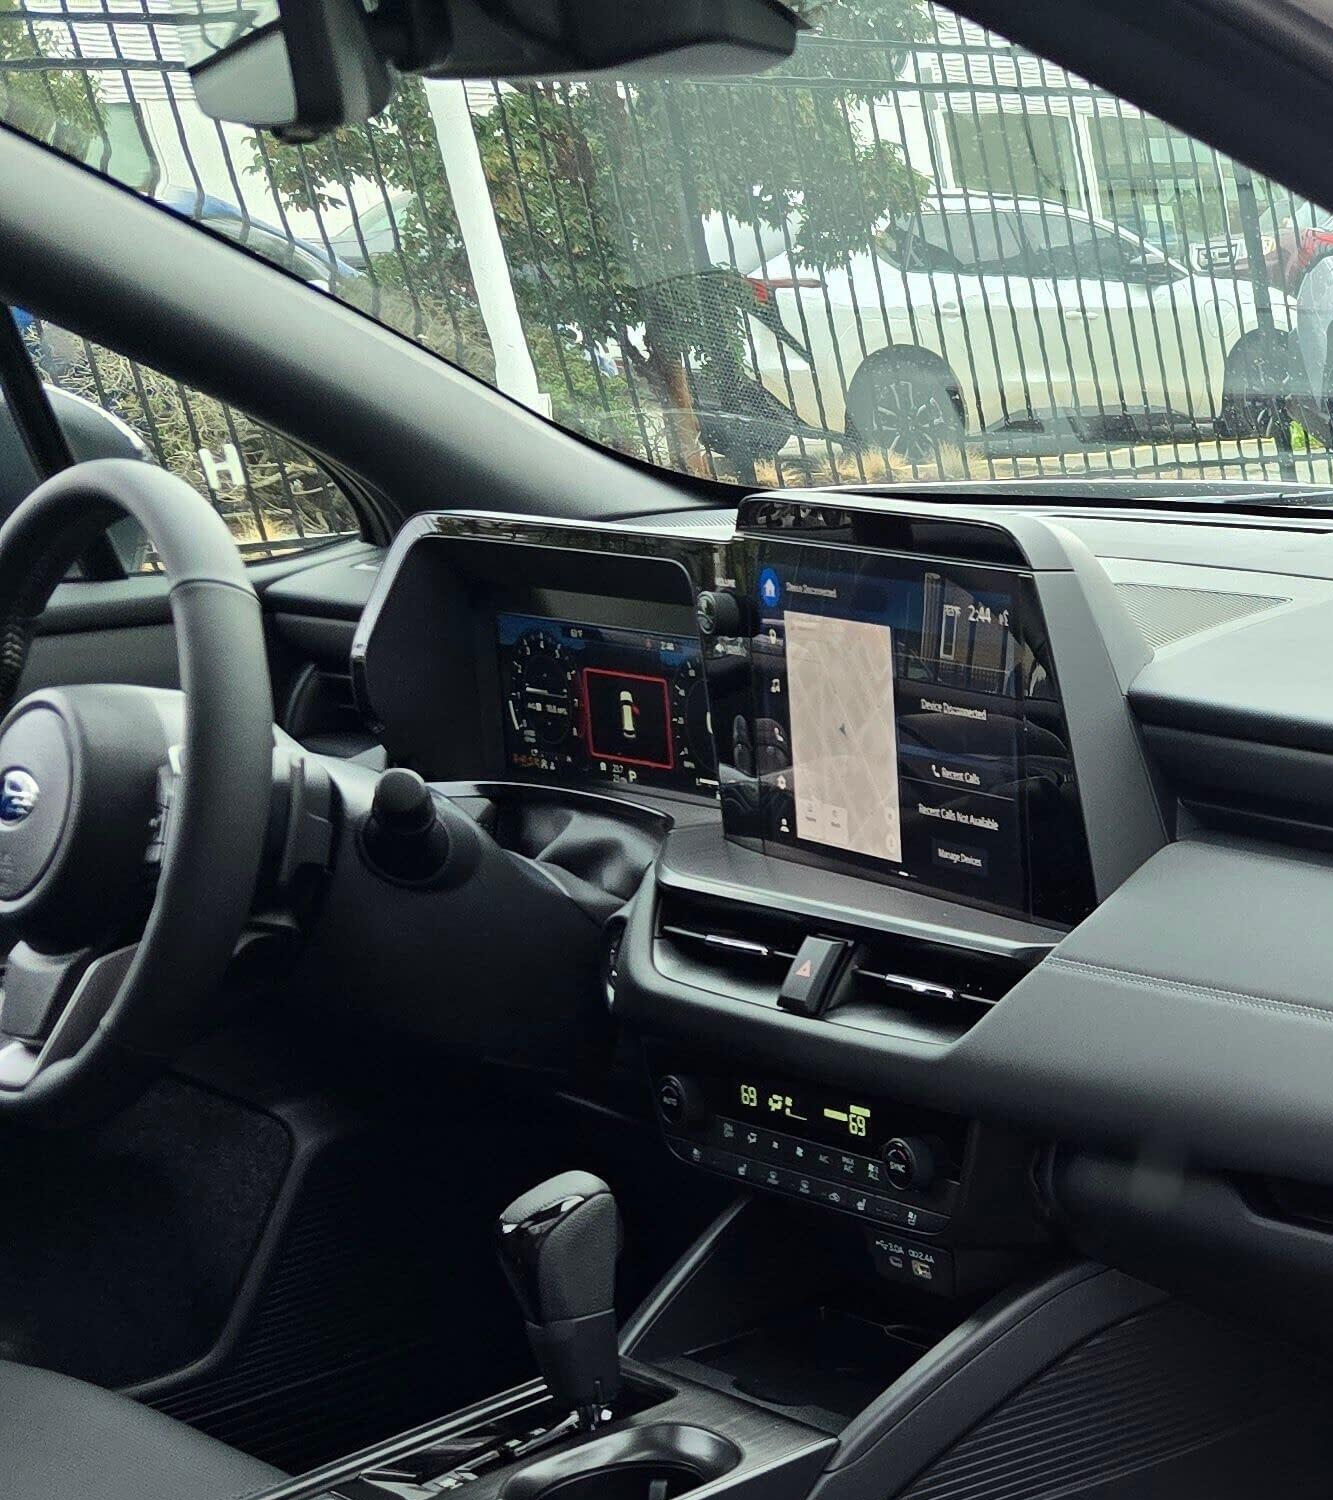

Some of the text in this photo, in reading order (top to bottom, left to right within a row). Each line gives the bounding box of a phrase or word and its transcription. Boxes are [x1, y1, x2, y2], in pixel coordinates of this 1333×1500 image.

[198, 444, 246, 490] H
[918, 802, 941, 818] Recent
[740, 1084, 757, 1107] 69
